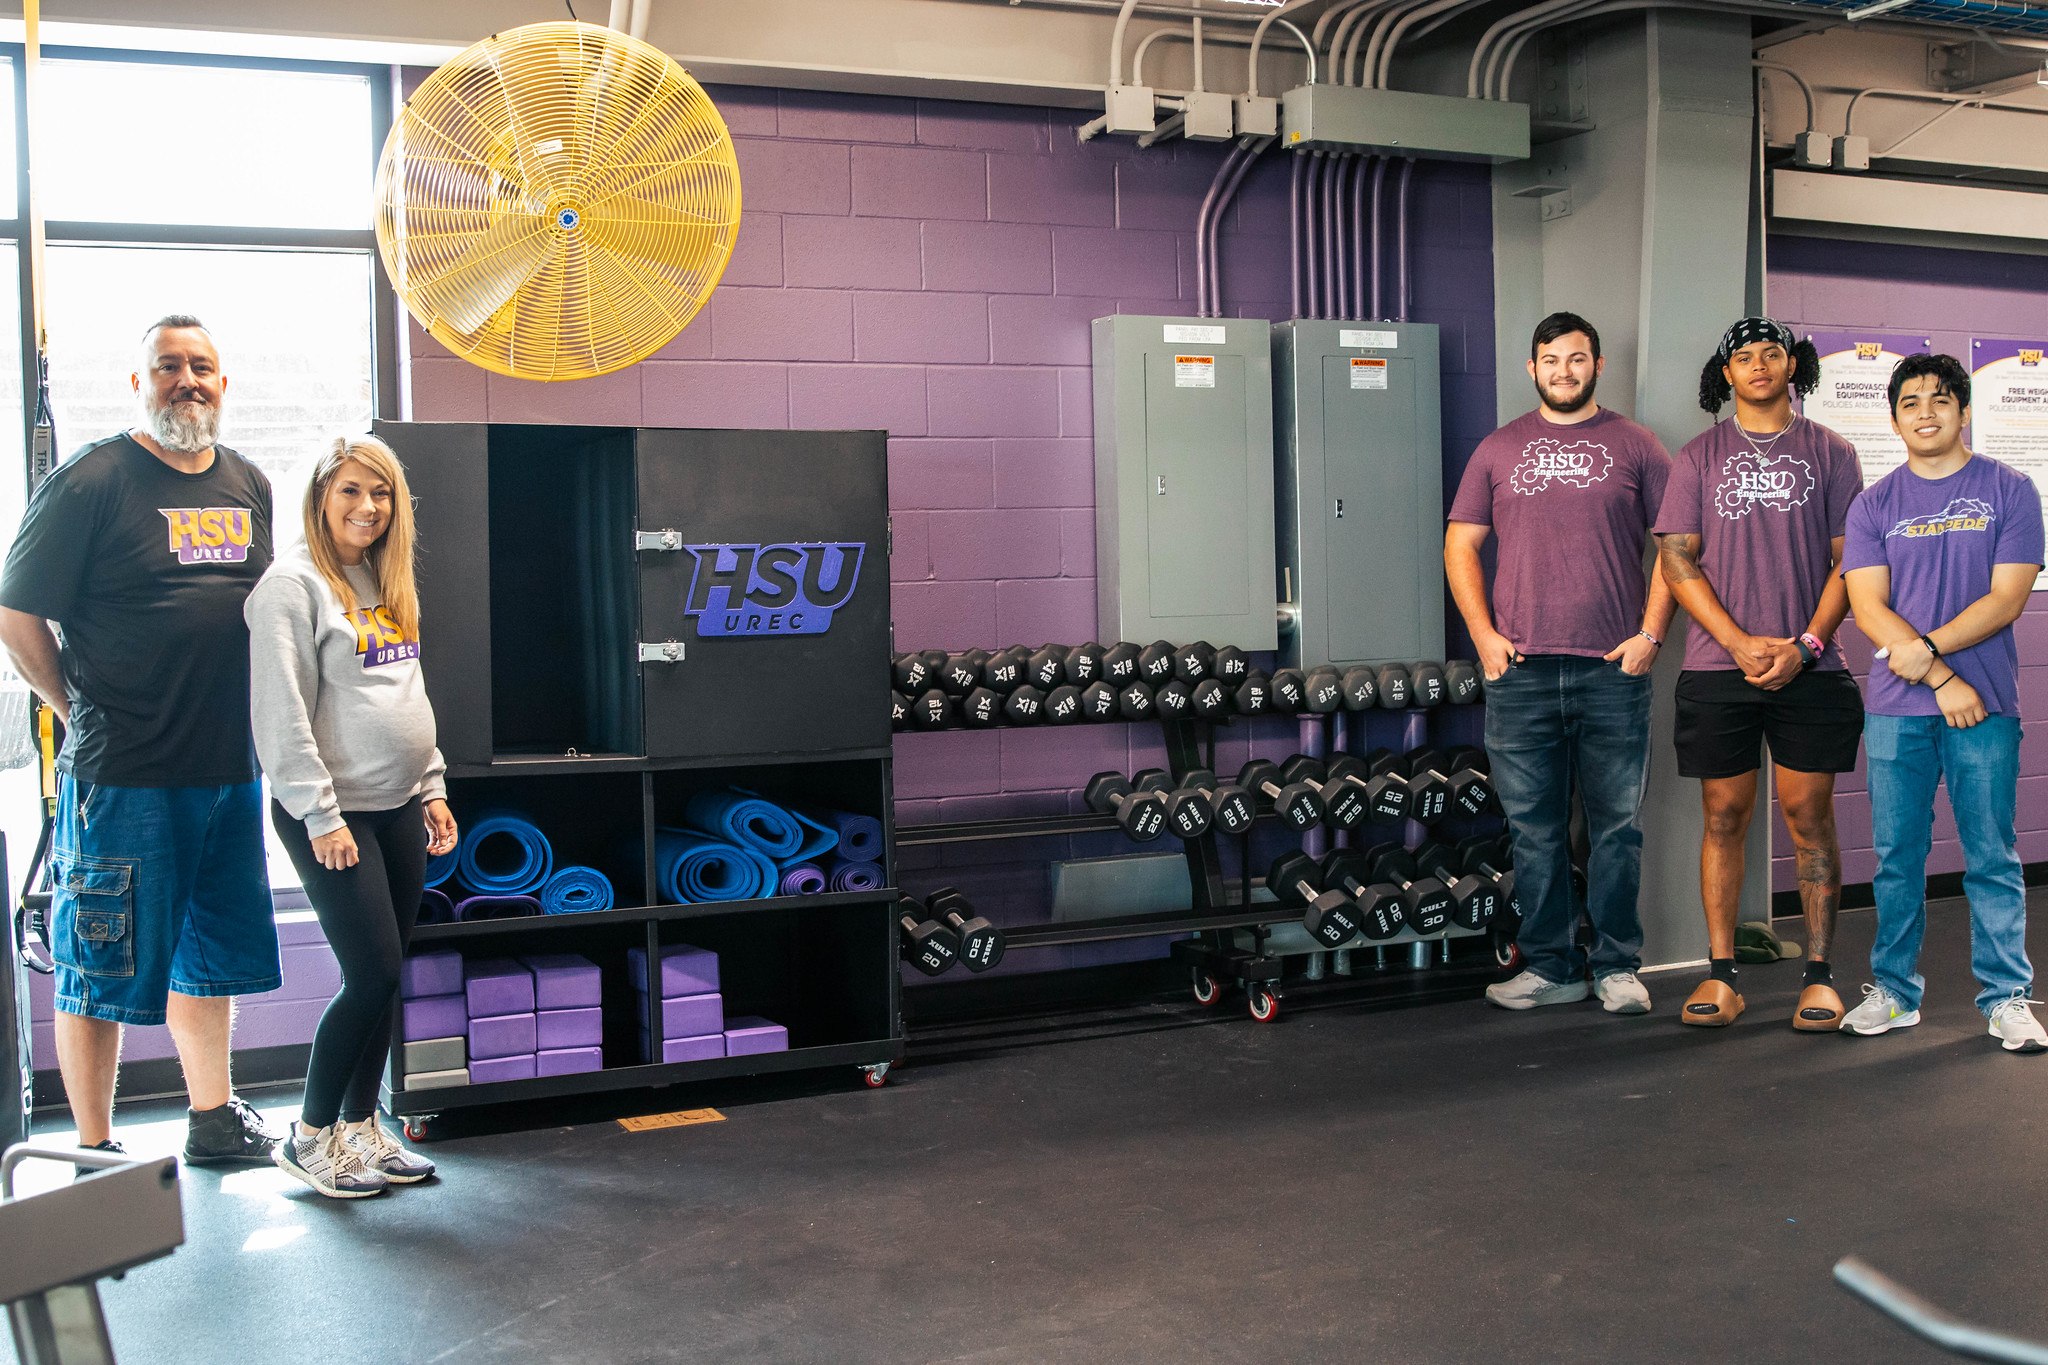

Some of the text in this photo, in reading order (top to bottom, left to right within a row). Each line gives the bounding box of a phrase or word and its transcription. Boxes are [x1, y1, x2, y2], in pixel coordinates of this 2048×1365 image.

[1856, 344, 1882, 356] HSU
[2020, 350, 2042, 363] HSU
[1835, 382, 1888, 390] CARDIOVASCU
[1836, 392, 1880, 400] EQUIPMENT
[2002, 396, 2040, 404] EQUIPMENT
[38, 450, 48, 476] TRX
[1537, 454, 1586, 469] HSU
[1534, 468, 1589, 477] Engineering
[1739, 471, 1788, 490] HSU
[1736, 489, 1790, 500] Engineering
[165, 510, 250, 548] HSU
[193, 548, 232, 560] UREC
[686, 547, 862, 612] HSU
[343, 605, 405, 653] HS
[724, 613, 804, 632] UREC
[377, 645, 414, 663] UREC
[1080, 656, 1092, 664] 12
[913, 663, 925, 674] 12
[1126, 659, 1132, 673] 12
[1160, 656, 1168, 670] 12
[1191, 666, 1202, 675] 12
[1226, 660, 1233, 673] 12
[963, 674, 973, 686] 12
[1008, 665, 1015, 679] 12
[1040, 672, 1051, 683] 12
[1099, 690, 1111, 700] 12
[1213, 688, 1222, 701] 12
[1281, 684, 1294, 694] 12
[1029, 701, 1037, 714] 12
[1066, 696, 1075, 710] 12
[1137, 699, 1148, 709] 12
[1177, 696, 1186, 709] 12
[976, 711, 988, 720] 12
[1384, 791, 1403, 802] 25
[1470, 785, 1486, 801] 25
[1233, 798, 1250, 821] XULT
[1301, 796, 1317, 818] XULT
[1335, 792, 1356, 817] XULT
[1422, 791, 1432, 818] XULT
[1434, 792, 1444, 813] 25
[1459, 797, 1478, 814] XULT
[1136, 804, 1153, 832] XULT
[1188, 802, 1204, 824] XULT
[1223, 808, 1238, 827] 20
[1293, 807, 1305, 824] 20
[1344, 806, 1362, 824] 25
[1377, 805, 1400, 817] XULT
[1148, 814, 1162, 834] 20
[1178, 812, 1192, 831] 20
[1390, 902, 1402, 922] 30
[1420, 900, 1448, 914] XULT
[1471, 897, 1480, 923] XULT
[1485, 896, 1494, 916] 30
[1333, 912, 1354, 930] XULT
[1376, 909, 1389, 933] XULT
[1424, 914, 1444, 927] 30
[1323, 925, 1340, 941] 30
[928, 939, 952, 958] XULT
[969, 938, 981, 958] 20
[982, 936, 995, 964] XULT
[922, 952, 940, 968] 20
